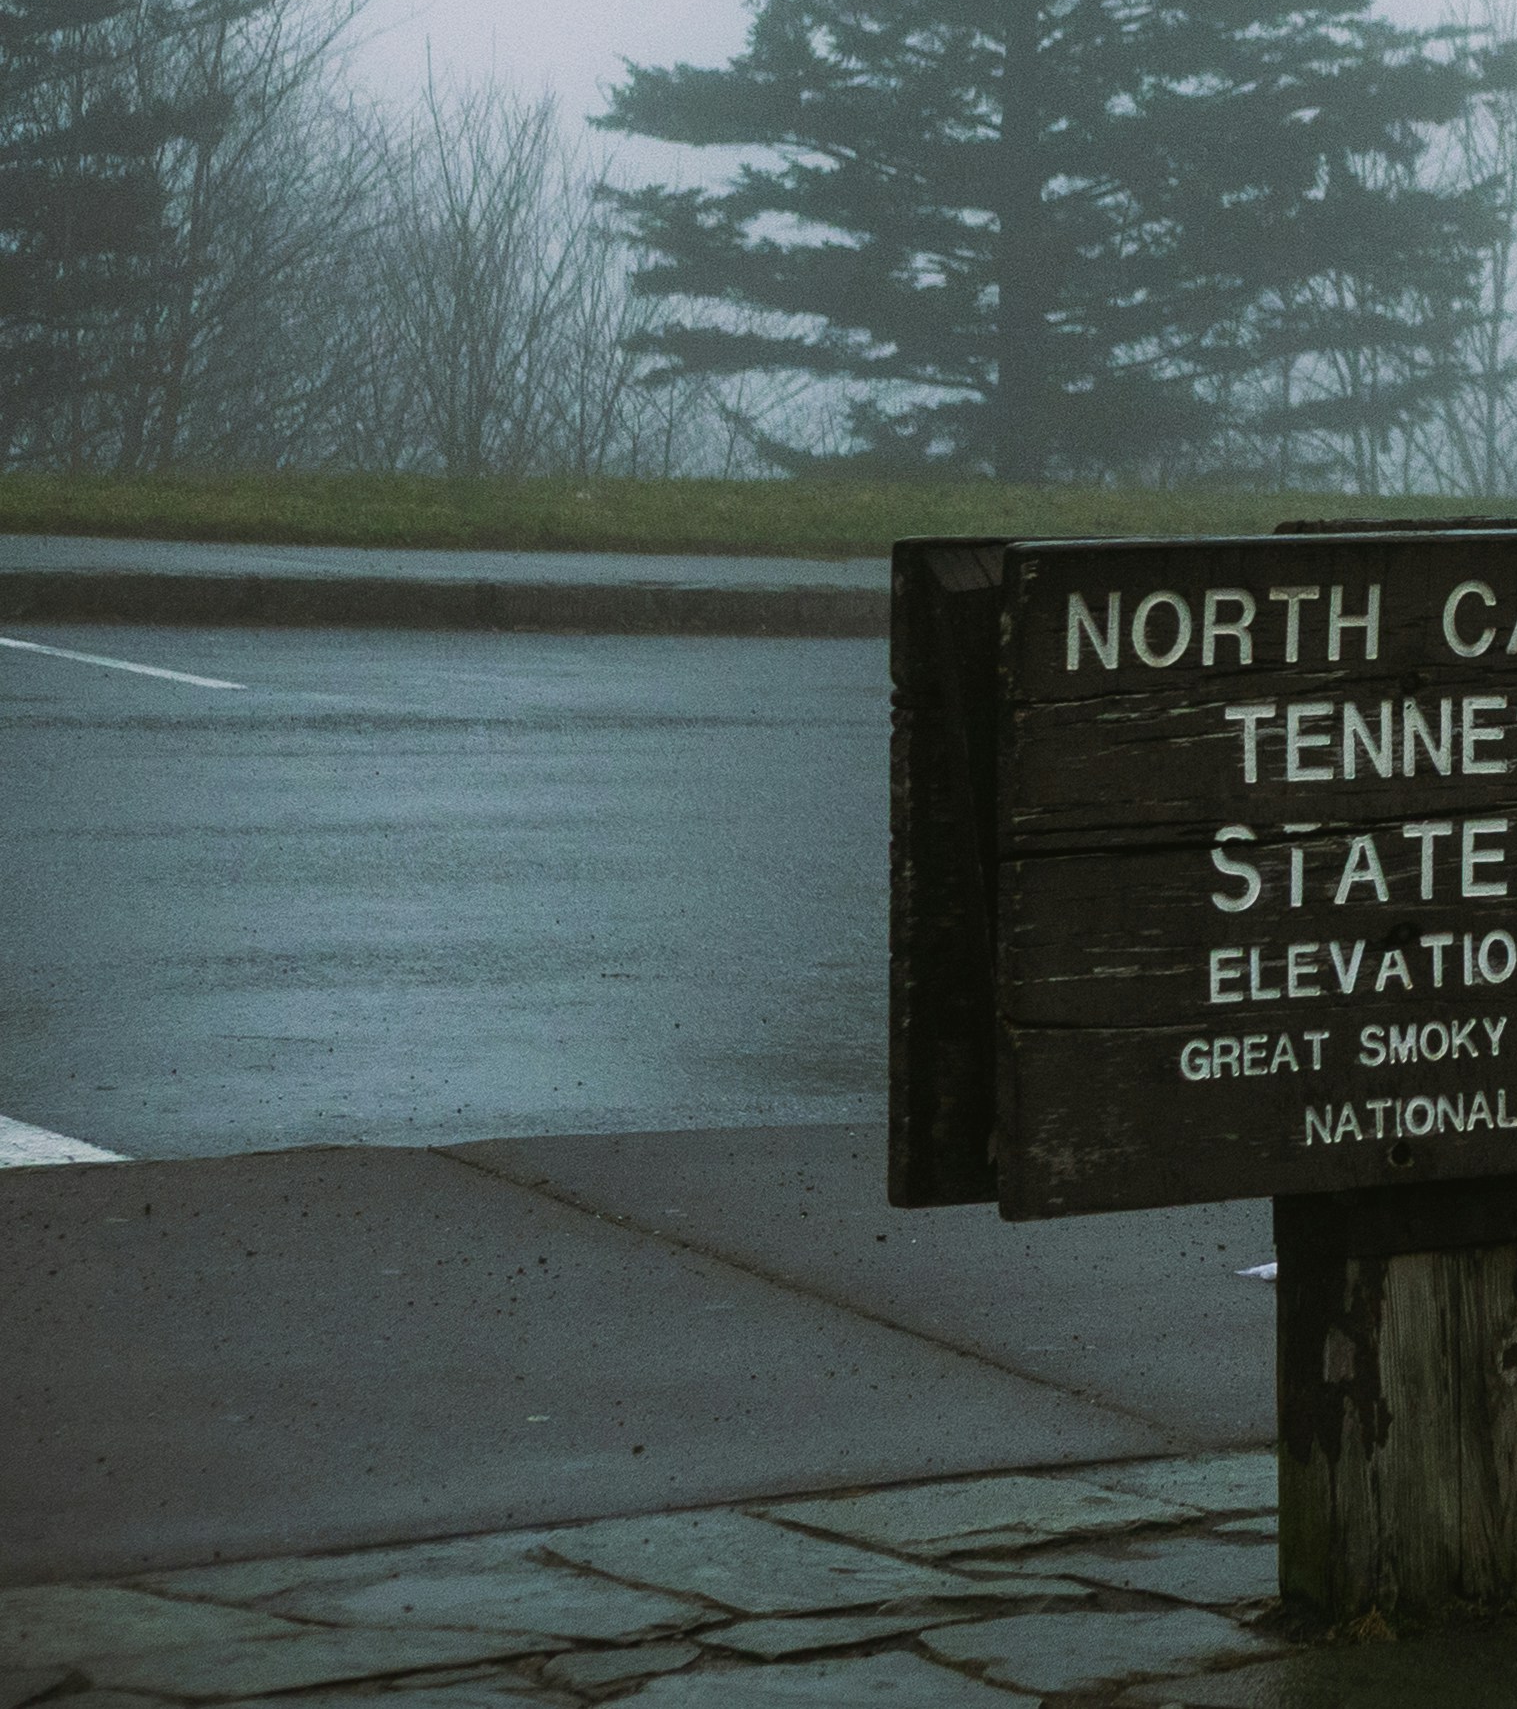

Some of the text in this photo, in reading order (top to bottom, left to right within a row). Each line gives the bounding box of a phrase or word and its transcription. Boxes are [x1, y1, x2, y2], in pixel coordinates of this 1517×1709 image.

[1065, 583, 1381, 671] NORTH
[1210, 818, 1510, 913] STATE
[1180, 1031, 1329, 1081] GREAT
[1359, 1017, 1507, 1067] SMOKY
